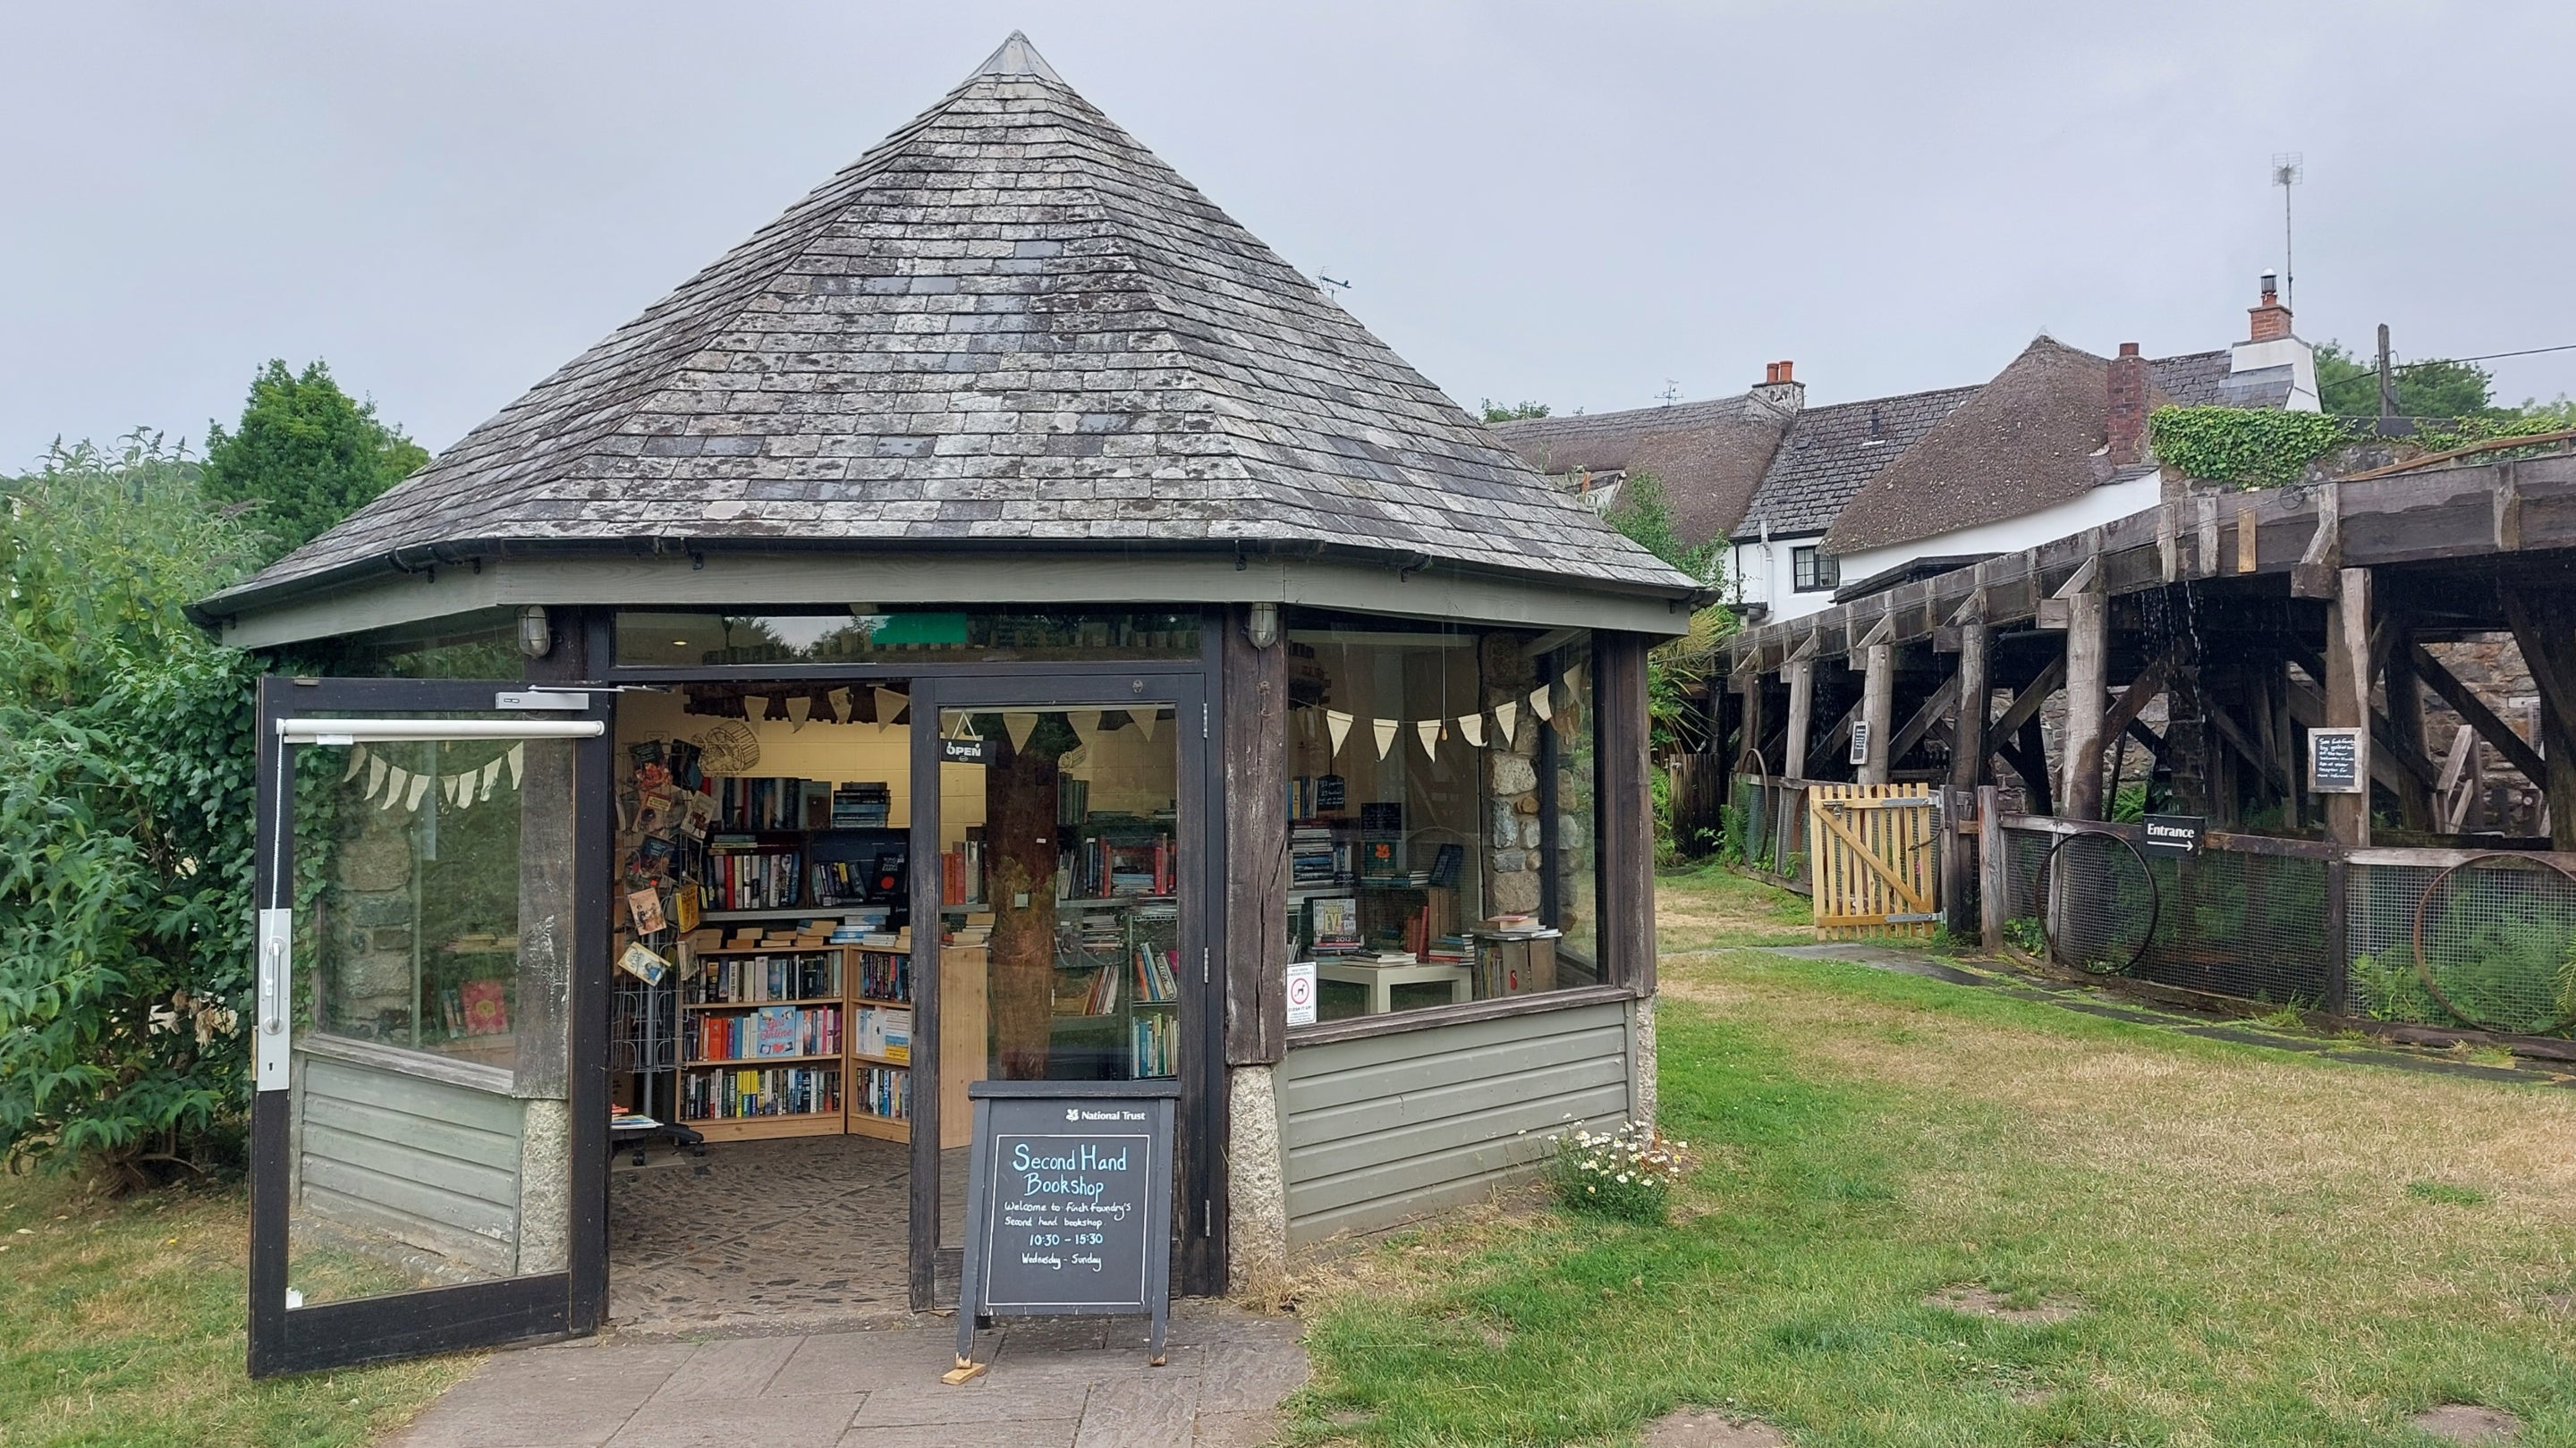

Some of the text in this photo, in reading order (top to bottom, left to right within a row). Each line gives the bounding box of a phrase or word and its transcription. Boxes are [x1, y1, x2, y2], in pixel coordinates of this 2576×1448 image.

[946, 745, 981, 757] OPEN
[2148, 823, 2195, 838] Entrance
[1081, 1111, 1146, 1121] National Trust
[1012, 1143, 1127, 1172] Second Hand
[1023, 1173, 1104, 1203] Bookshop
[1004, 1200, 1047, 1212] Welcome
[1051, 1202, 1060, 1212] to
[1004, 1215, 1032, 1227] Second
[1038, 1215, 1058, 1226] hand
[1030, 1233, 1060, 1247] 10:30
[1075, 1232, 1104, 1245] 15:30
[1021, 1251, 1062, 1270] Wednesday
[1071, 1252, 1102, 1273] Sunday
